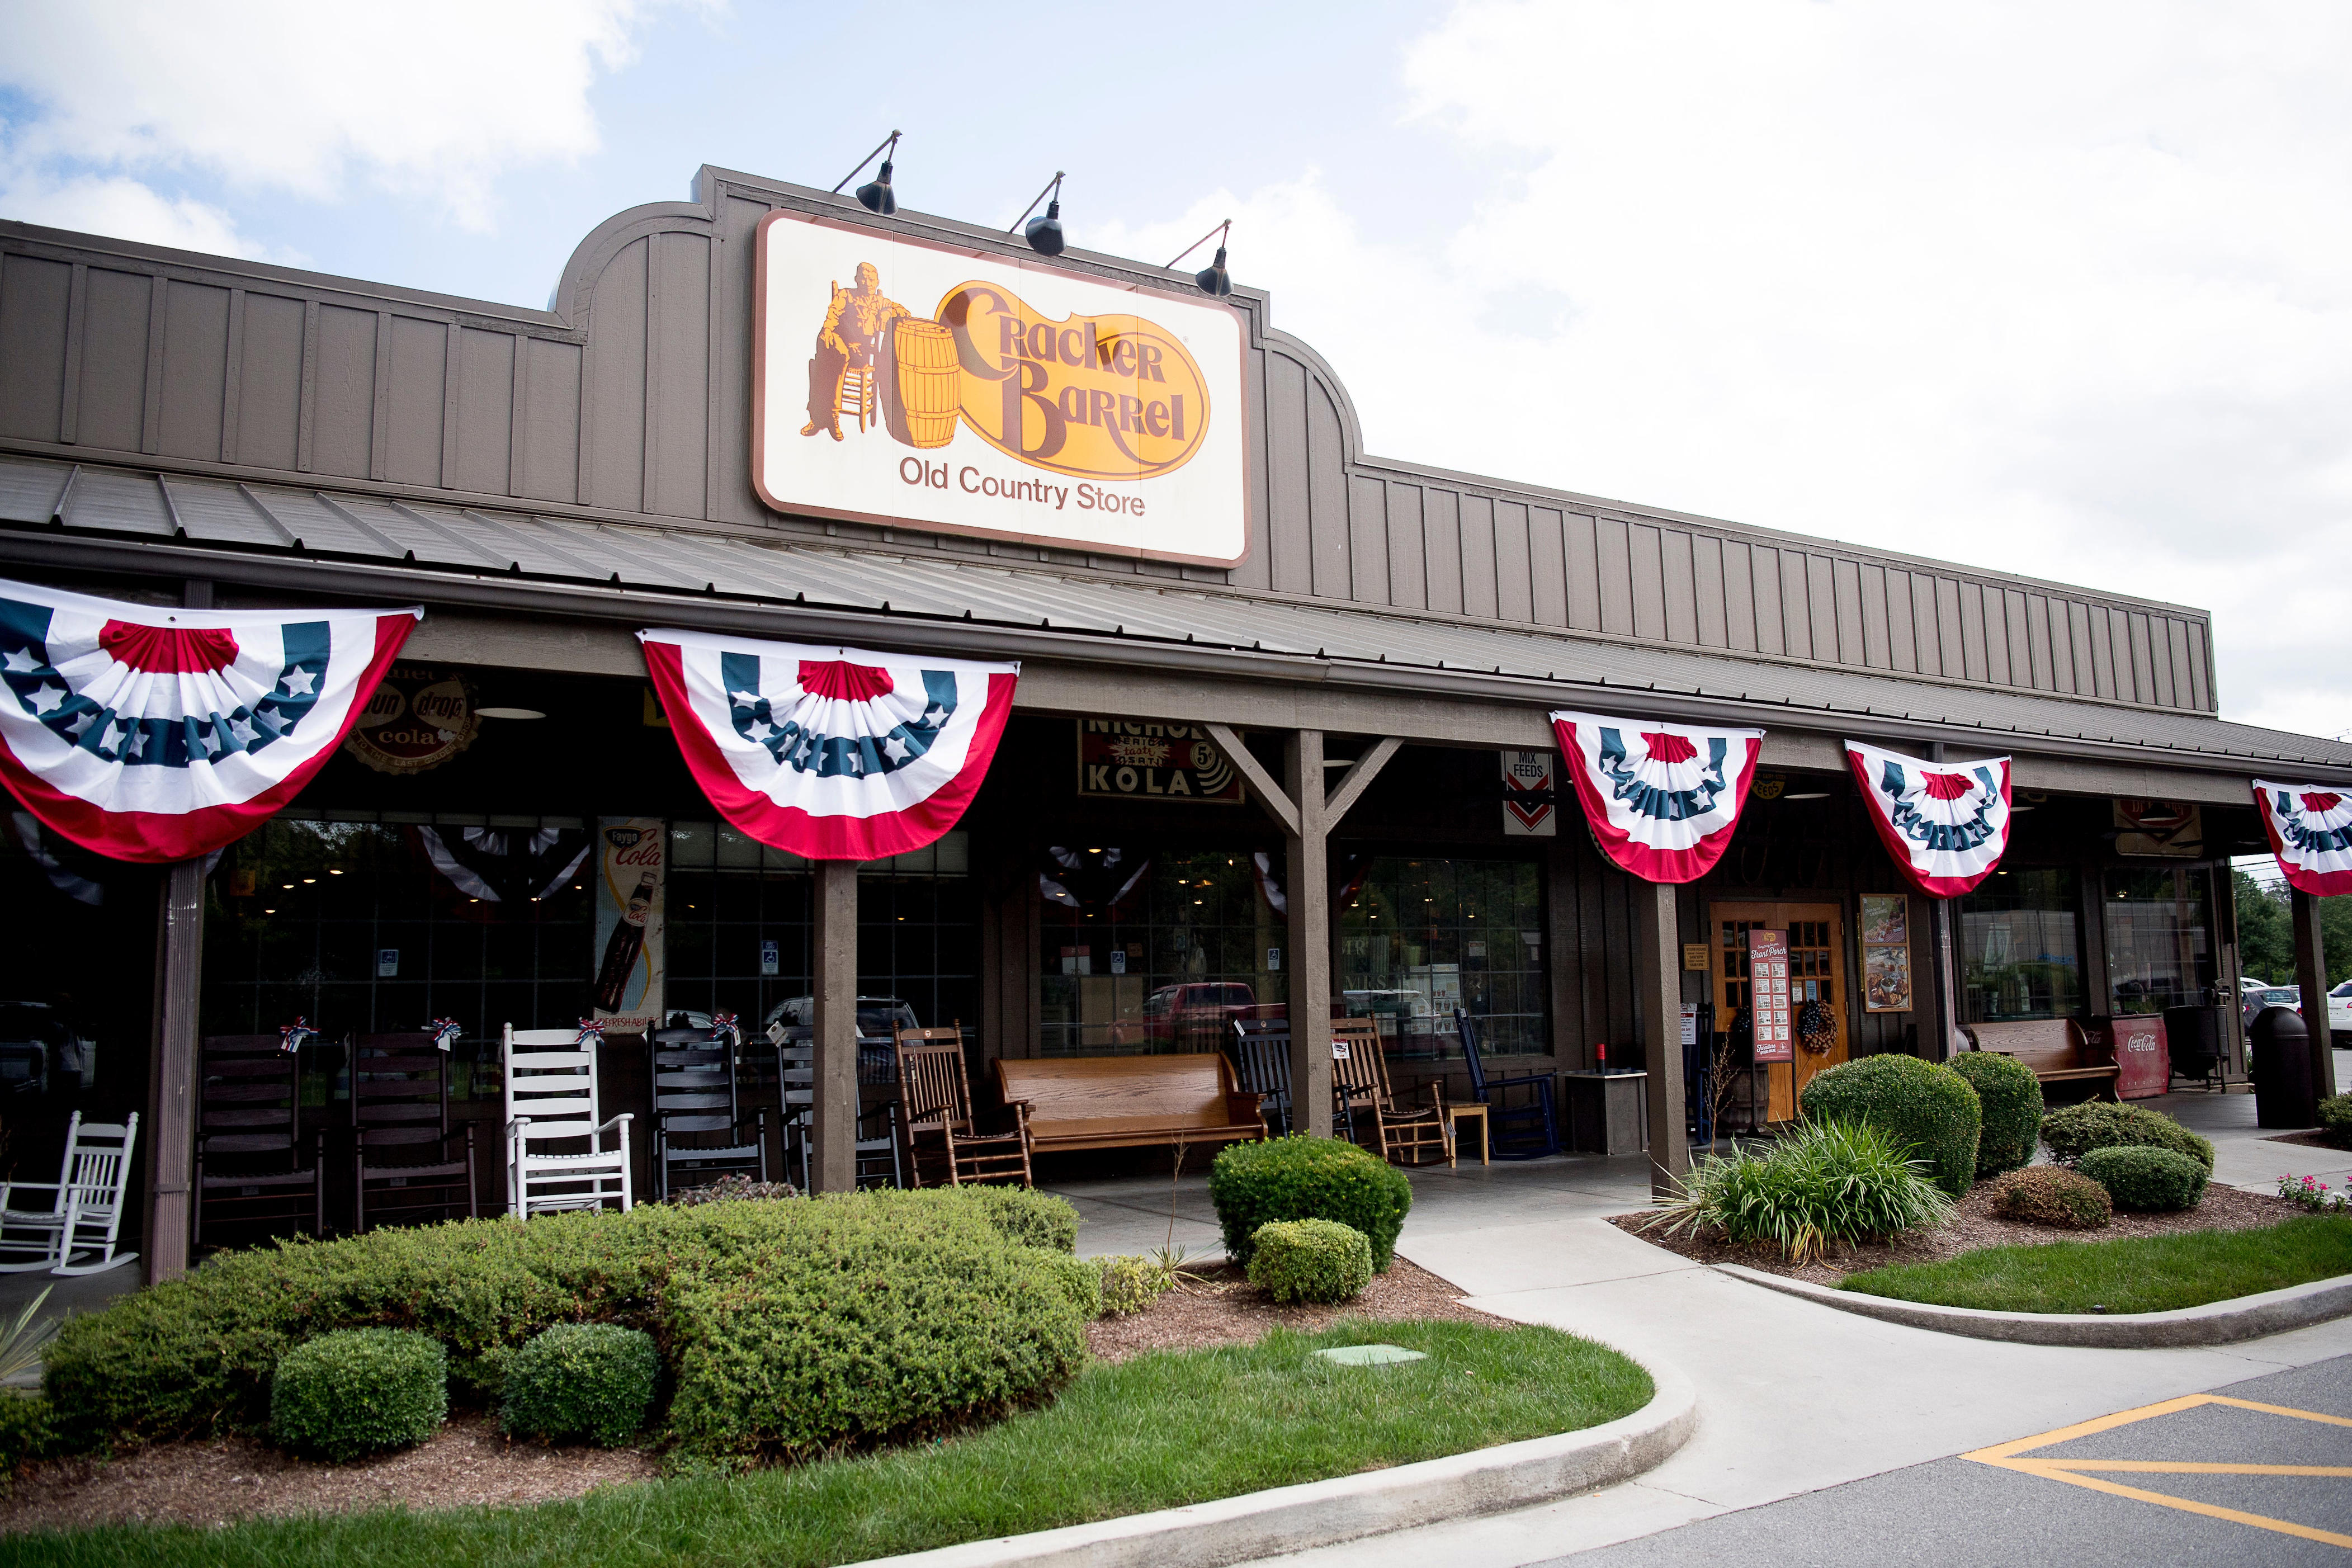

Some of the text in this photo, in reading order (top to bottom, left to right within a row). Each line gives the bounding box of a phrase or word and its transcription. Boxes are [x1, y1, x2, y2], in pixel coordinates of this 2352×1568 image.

[943, 286, 1165, 384] Cracker
[1000, 356, 1186, 464] Barrel
[900, 457, 1146, 517] Old Country Store
[362, 692, 464, 720] un drop
[370, 749, 389, 762] THE
[424, 743, 457, 764] GOLDEN
[456, 716, 471, 742] DROP
[378, 729, 437, 744] cola
[1514, 764, 1543, 778] FEEDS
[1519, 752, 1537, 764] MIX
[1089, 764, 1192, 795] KOLA
[612, 831, 637, 844] Faygo
[616, 829, 661, 866] Cola
[1751, 950, 1769, 960] Front
[1769, 946, 1787, 956] Porch
[2128, 1034, 2156, 1052] Coca-Cola
